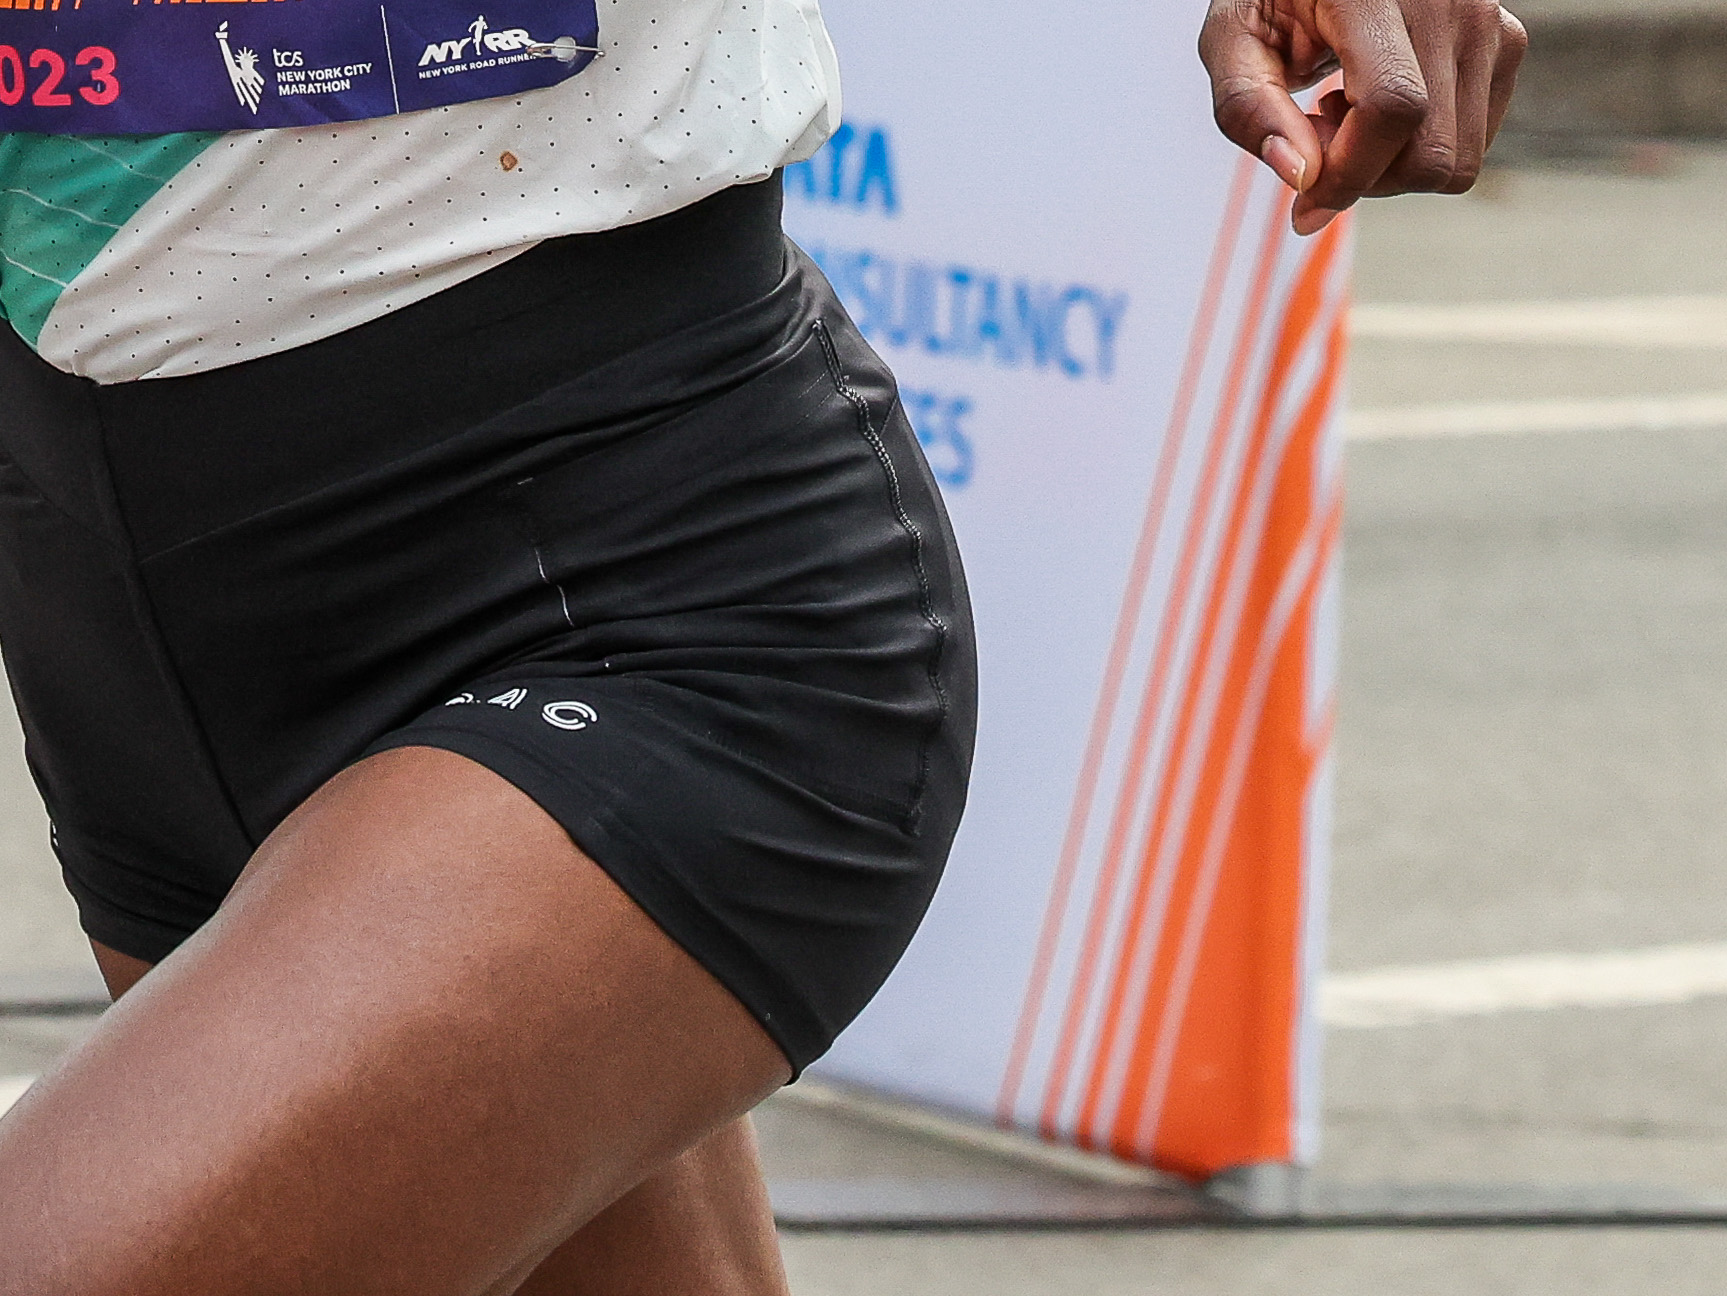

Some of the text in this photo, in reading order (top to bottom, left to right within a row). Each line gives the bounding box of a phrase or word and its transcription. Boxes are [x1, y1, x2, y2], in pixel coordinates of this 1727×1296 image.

[273, 48, 303, 67] tcs
[277, 62, 372, 83] NEW YORK CITY
[418, 68, 441, 80] NEW
[442, 64, 468, 76] YORK
[469, 59, 496, 70] ROAD
[278, 79, 351, 97] MARATHON
